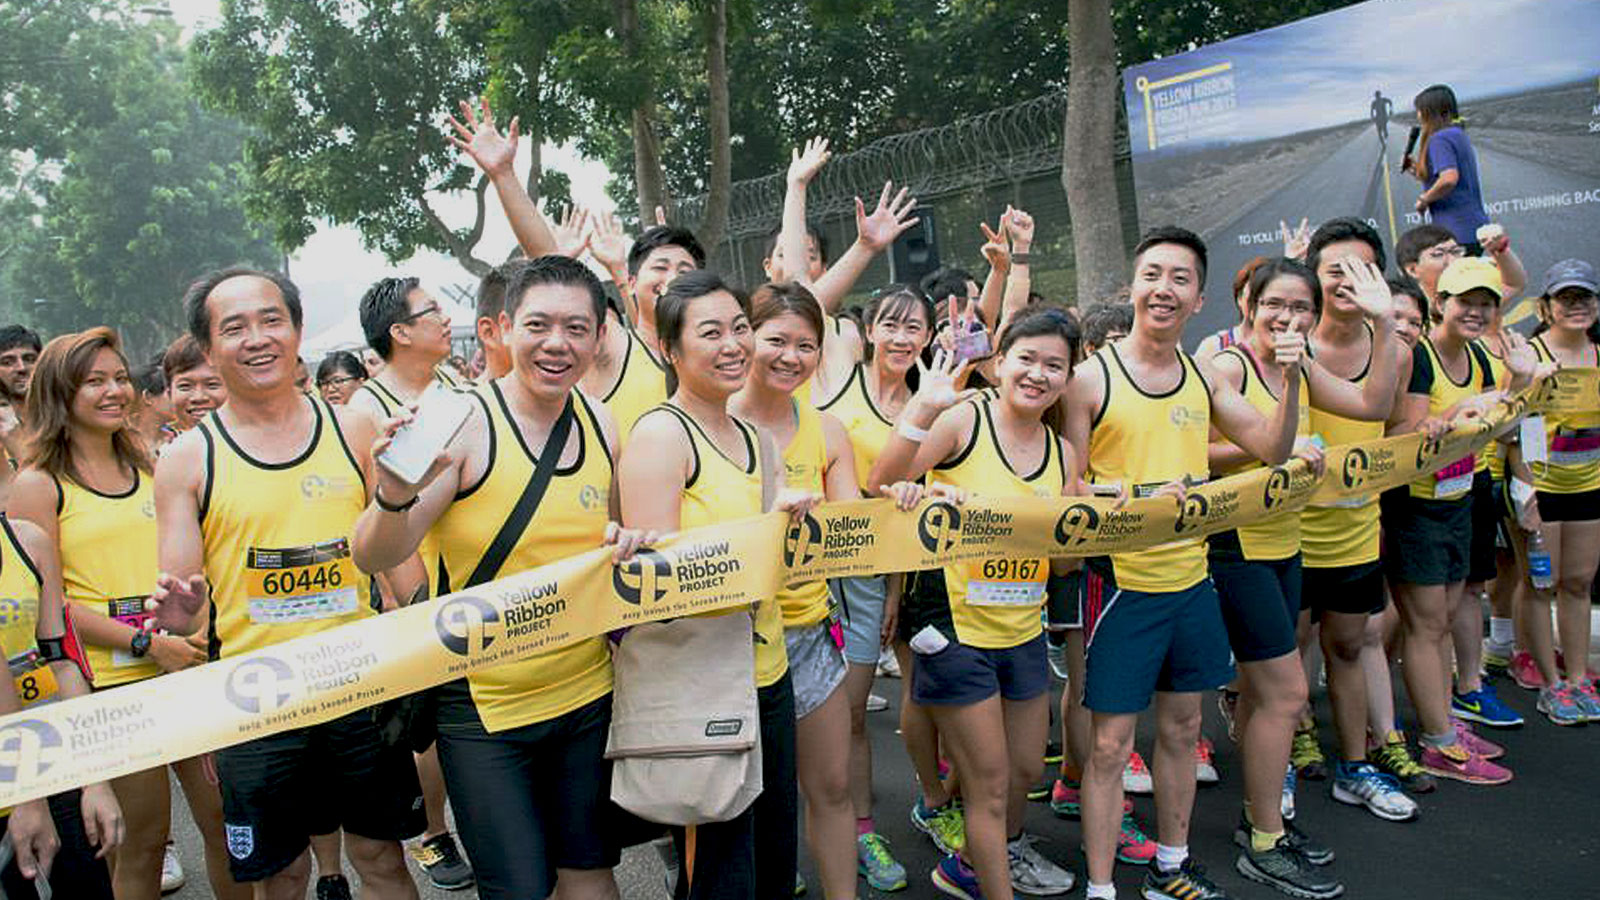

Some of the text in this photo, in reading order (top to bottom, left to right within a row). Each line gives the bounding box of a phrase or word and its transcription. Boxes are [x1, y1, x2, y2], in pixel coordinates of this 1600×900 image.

[1485, 200, 1512, 215] NOT
[1512, 191, 1572, 213] TURNING
[825, 516, 871, 533] Yellow
[966, 508, 1014, 523] Yellow
[1104, 510, 1144, 524] Yellow
[961, 522, 1014, 537] Ribbon
[1098, 524, 1143, 537] Ribbon
[674, 541, 730, 563] Yellow
[824, 532, 875, 550] Ribbon
[824, 547, 860, 559] PROJECT
[262, 563, 343, 595] 60446
[676, 558, 741, 583] Ribbon
[983, 558, 1041, 580] 69167
[500, 580, 559, 608] Yellow
[680, 576, 726, 593] PROJECT
[504, 597, 567, 628] Ribbon
[506, 617, 554, 640] PROJECT
[296, 636, 363, 665] Yellow
[302, 650, 379, 683] Ribbon
[65, 700, 144, 732] Yellow
[69, 715, 157, 751] Ribbon
